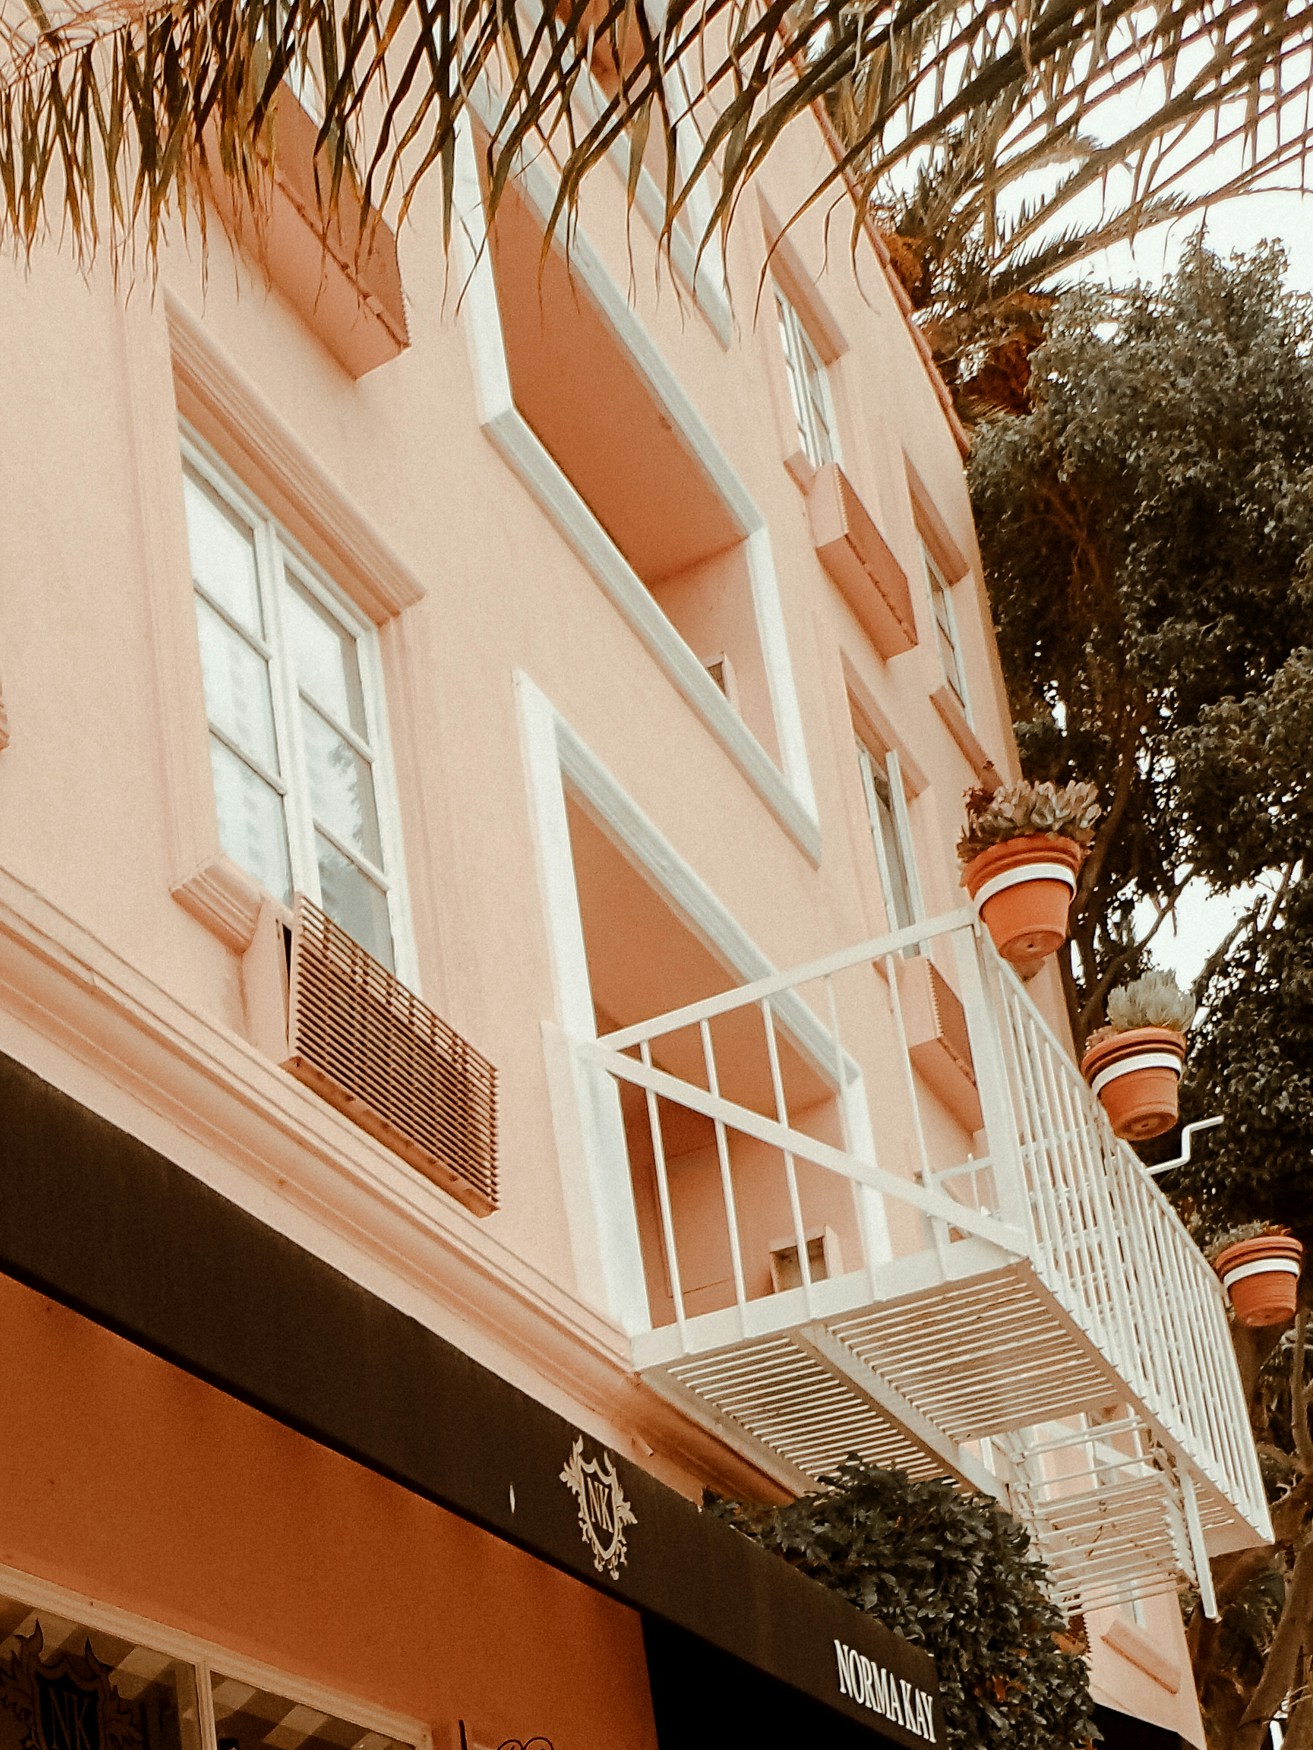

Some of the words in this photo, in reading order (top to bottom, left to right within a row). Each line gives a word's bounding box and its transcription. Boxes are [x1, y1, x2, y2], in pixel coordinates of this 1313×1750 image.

[586, 1476, 614, 1534] NK
[833, 1639, 905, 1726] NORMA
[899, 1679, 937, 1743] KAY
